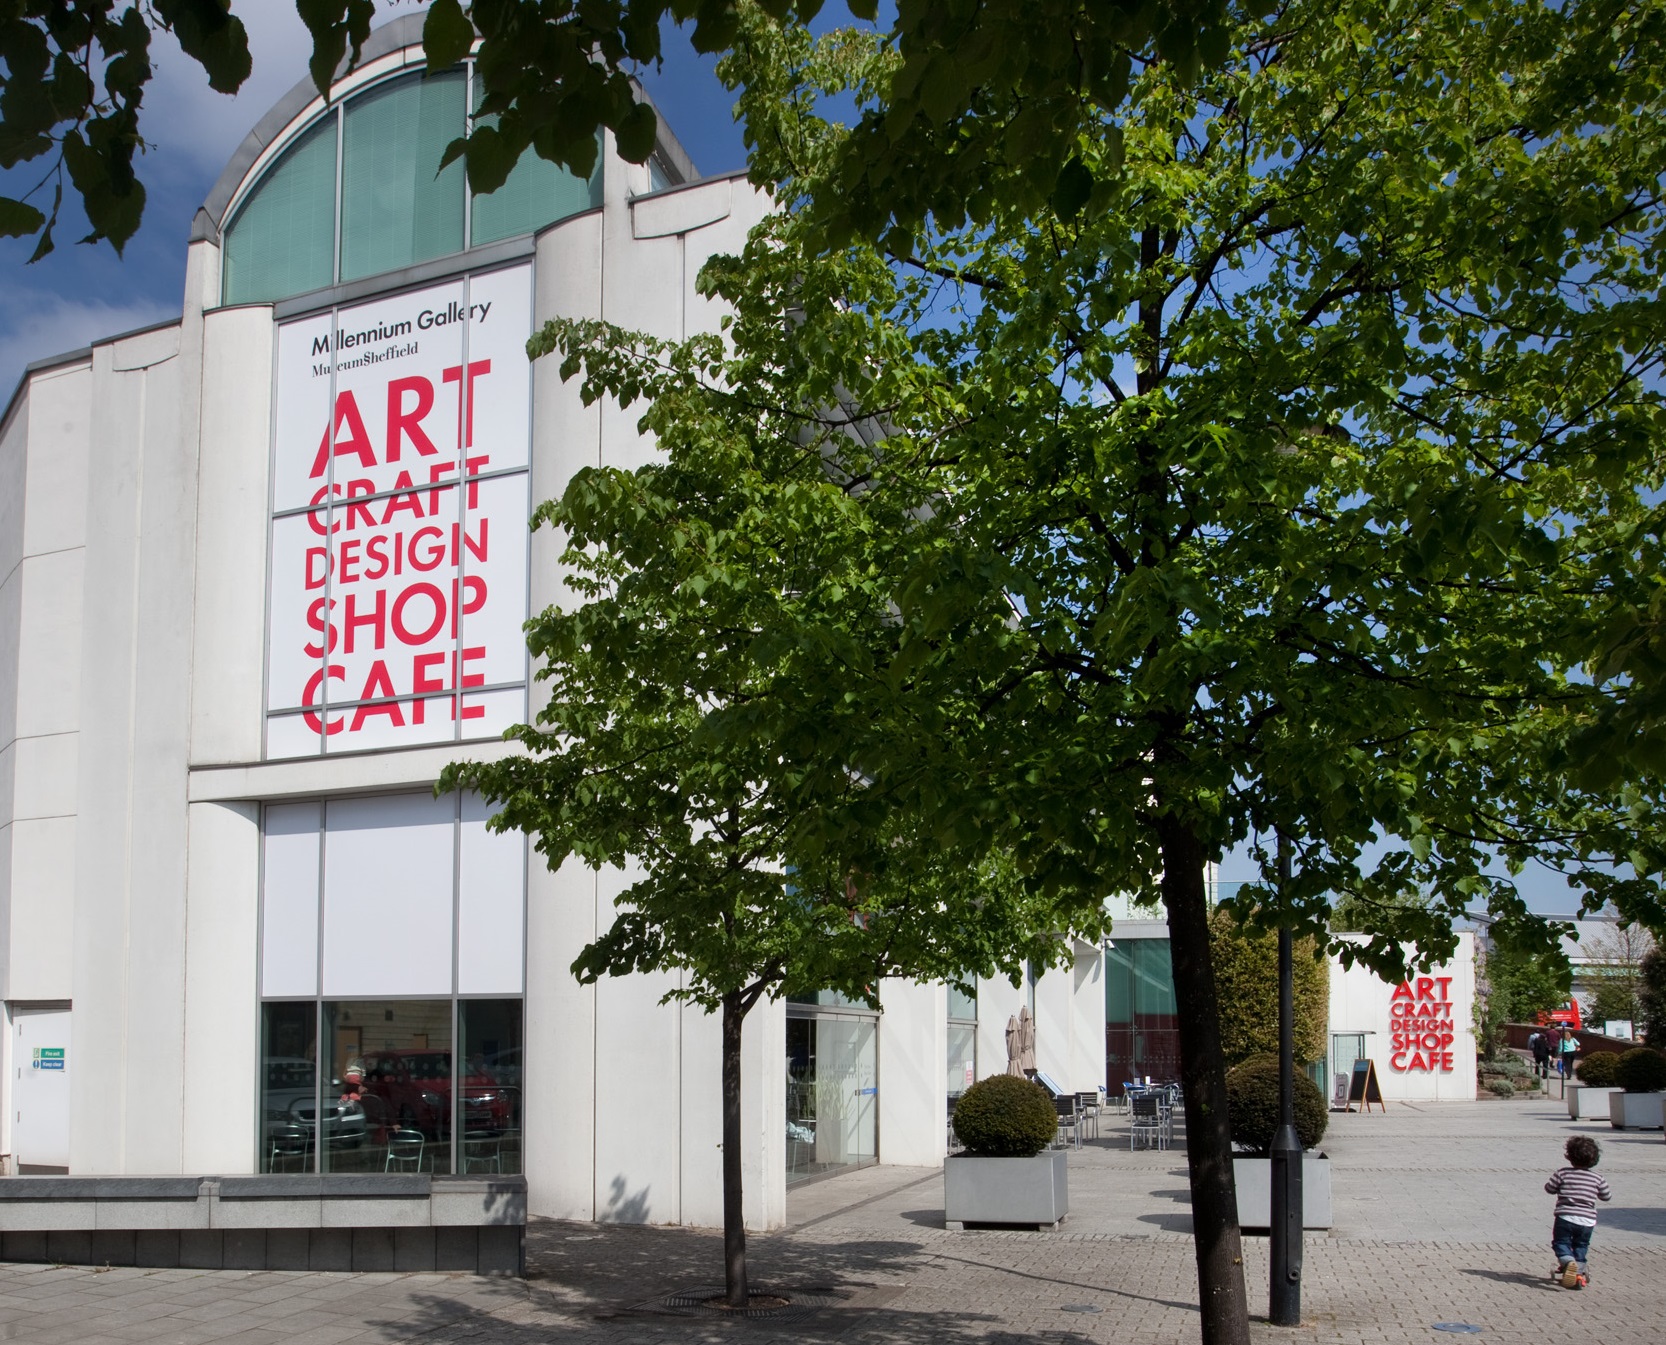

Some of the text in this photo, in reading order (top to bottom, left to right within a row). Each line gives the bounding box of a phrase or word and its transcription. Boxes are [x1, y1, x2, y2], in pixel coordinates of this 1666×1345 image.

[312, 301, 492, 357] Mllennium Gallery
[309, 359, 491, 479] ART
[307, 455, 490, 538] CRAFT
[305, 518, 489, 592] DESIGN
[303, 575, 488, 659] SHOP
[300, 645, 487, 737] CAFE
[1391, 976, 1453, 1001] ART
[1391, 1002, 1453, 1019] CRAFT
[1391, 1019, 1454, 1032] DESIGN
[1391, 1033, 1454, 1051] SHOP
[1391, 1051, 1454, 1071] CAFE
